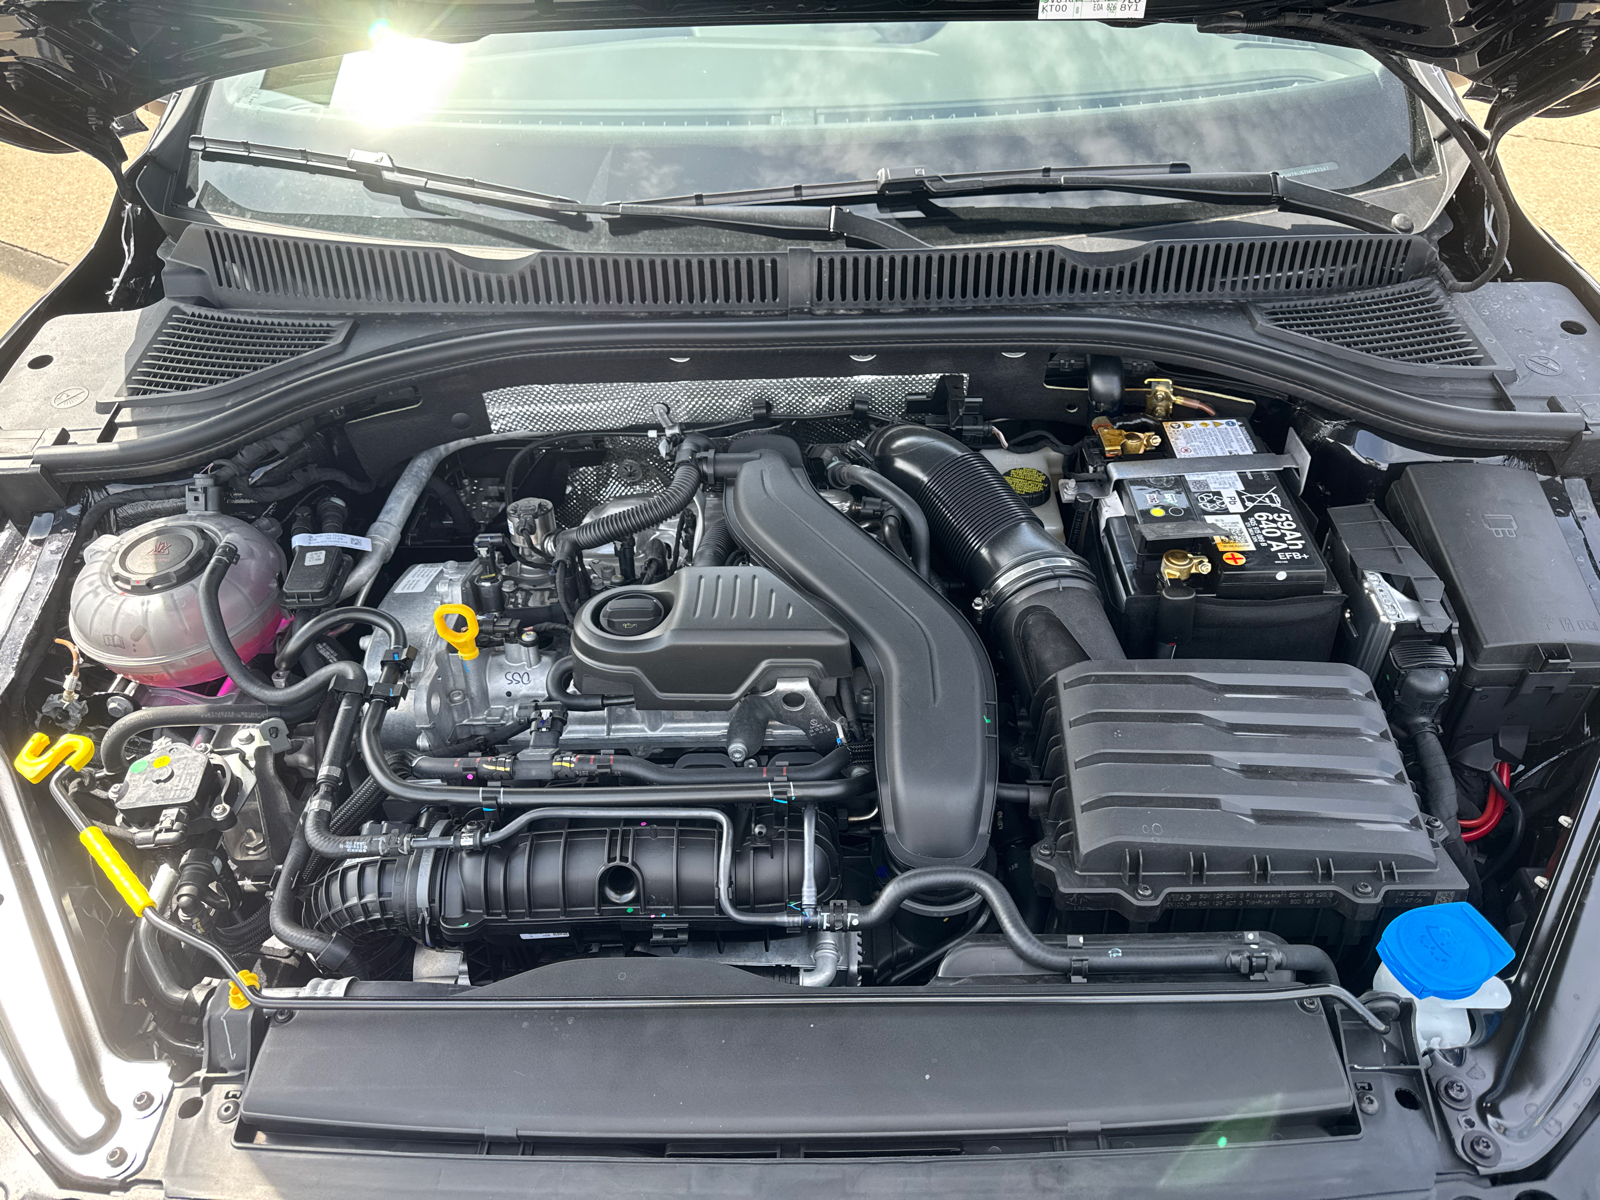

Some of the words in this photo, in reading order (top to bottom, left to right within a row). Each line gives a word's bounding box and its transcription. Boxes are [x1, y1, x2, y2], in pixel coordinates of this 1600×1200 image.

[1226, 496, 1238, 505] Pb
[1254, 512, 1282, 537] 640
[1273, 513, 1306, 550] 59Ah
[1266, 540, 1288, 552] A
[1277, 552, 1309, 560] EFB+
